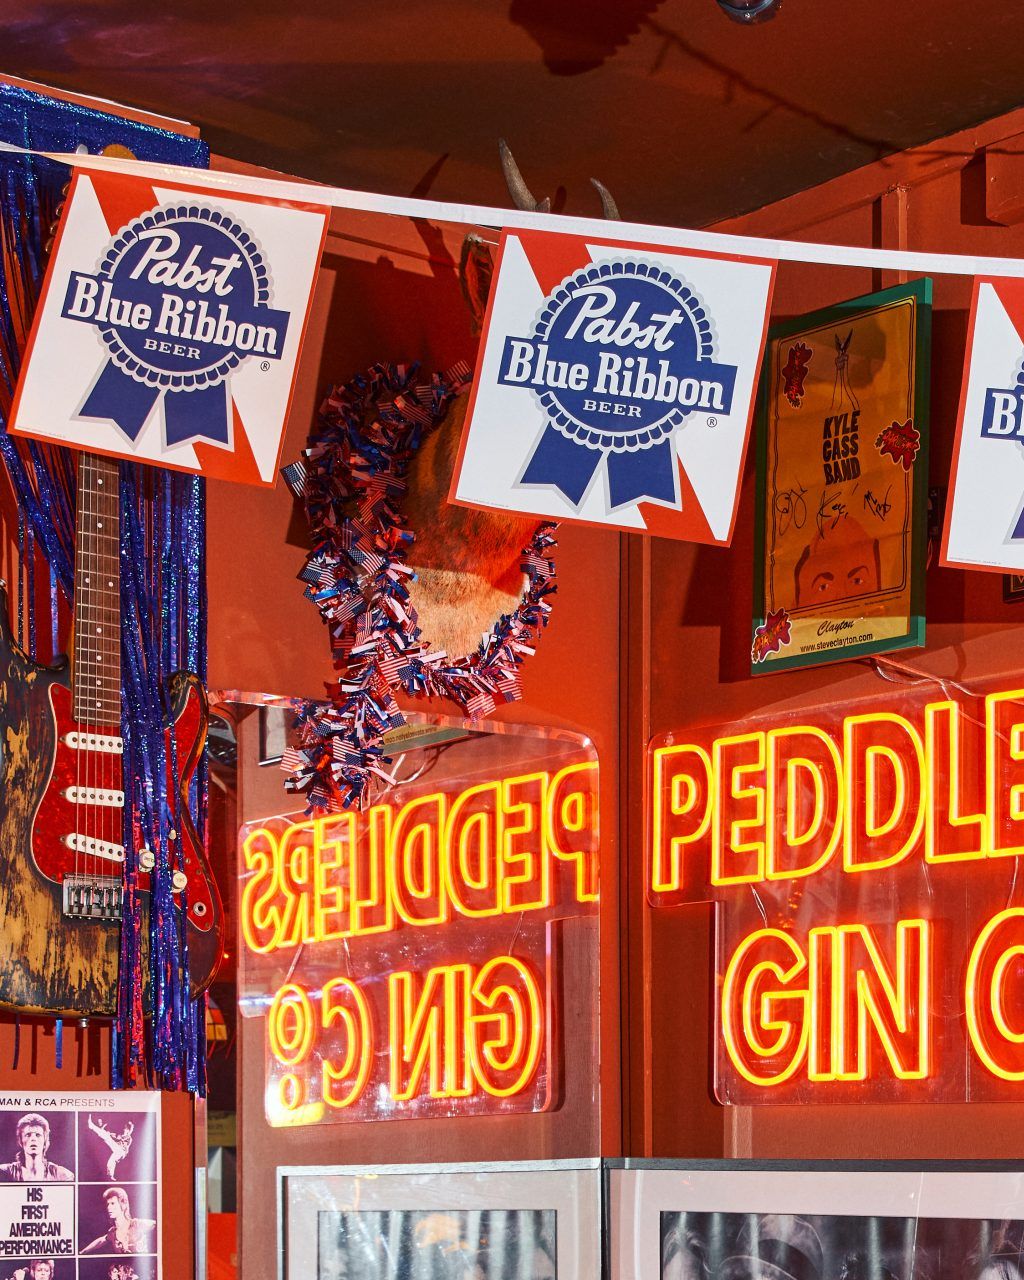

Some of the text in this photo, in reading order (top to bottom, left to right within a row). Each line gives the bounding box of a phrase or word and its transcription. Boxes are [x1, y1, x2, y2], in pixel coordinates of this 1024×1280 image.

[132, 228, 242, 295] Pabst
[69, 276, 278, 356] Blue Ribbon
[566, 285, 684, 351] Pabst
[143, 338, 202, 361] BEER
[504, 341, 587, 390] Blue
[593, 355, 724, 410] Ribbon
[583, 399, 642, 419] BEER
[823, 410, 861, 440] KYLE
[822, 433, 859, 461] GASS
[823, 455, 862, 486] BAND
[816, 619, 855, 636] Clayton
[800, 633, 873, 653] www.steveclayton.com
[721, 918, 929, 1087] GIN
[24, 1098, 31, 1106] &
[35, 1098, 57, 1106] RCA
[60, 1098, 115, 1108] PRESENTS
[27, 1187, 43, 1202] HIS
[21, 1204, 49, 1220] FIRST
[9, 1222, 61, 1238] AMERICAN
[0, 1238, 73, 1255] PERFORMANCE
